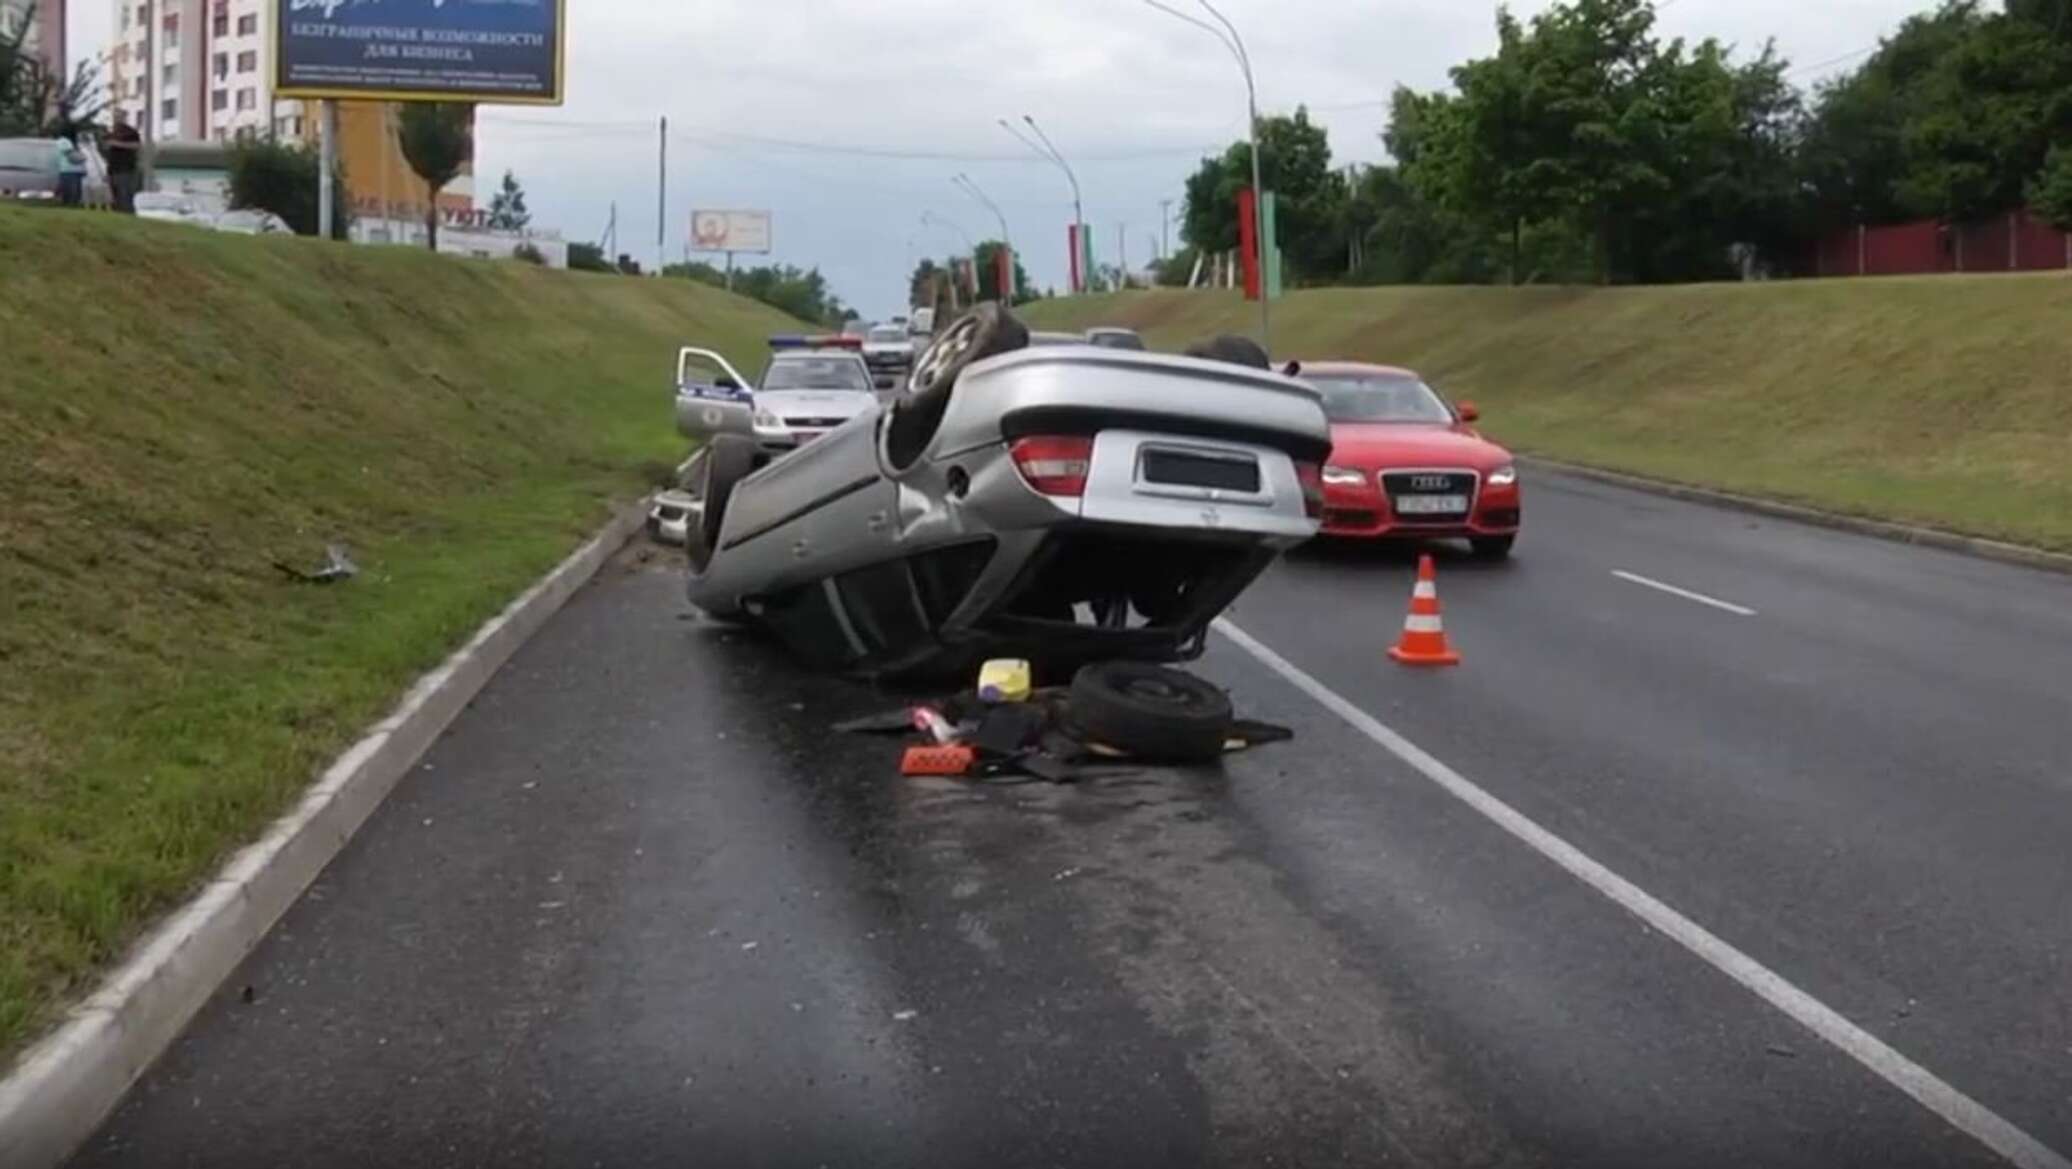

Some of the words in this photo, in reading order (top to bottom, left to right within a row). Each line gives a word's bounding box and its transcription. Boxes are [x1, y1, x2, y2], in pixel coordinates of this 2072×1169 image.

[291, 22, 420, 42] БЕЗГРАНИЧНЫЕ
[422, 28, 544, 46] ВОЗМОЖНОСТИ
[363, 44, 398, 58] ДЛЯ
[401, 46, 474, 62] БИЗНЕСА
